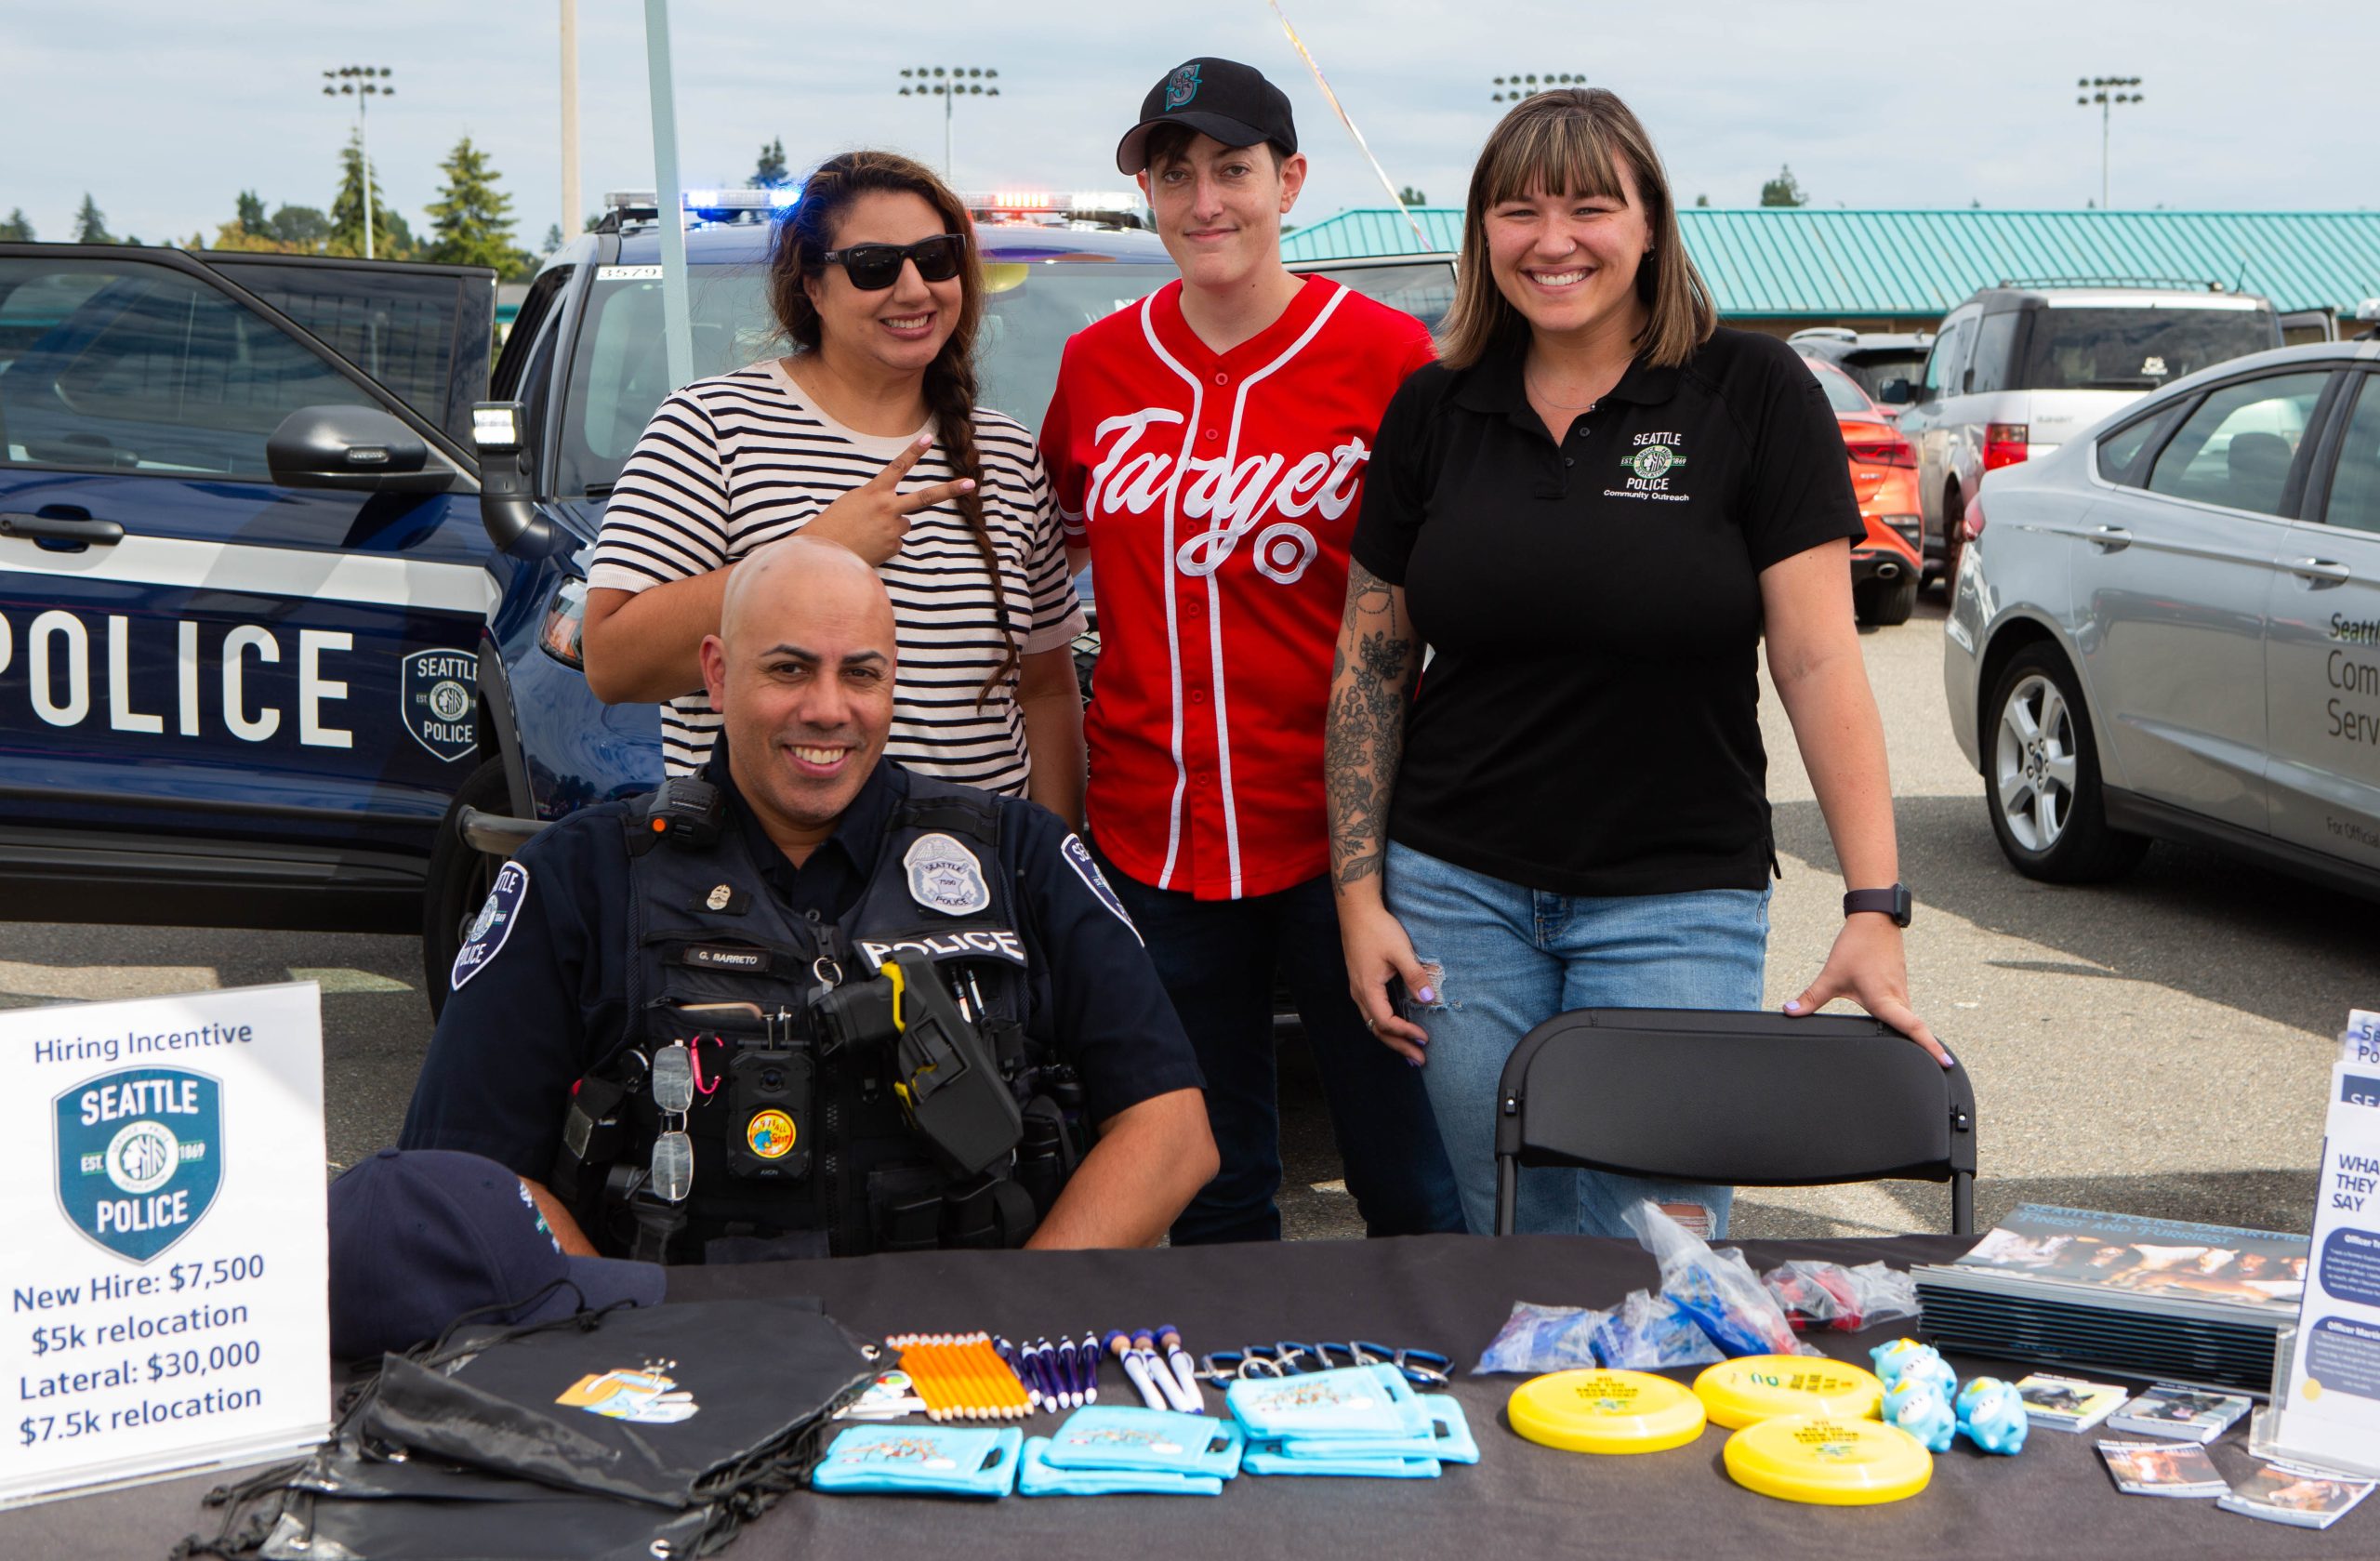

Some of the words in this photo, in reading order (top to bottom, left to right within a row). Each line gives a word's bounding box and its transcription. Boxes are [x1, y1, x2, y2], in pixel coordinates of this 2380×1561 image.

[600, 269, 663, 278] 3579
[1633, 432, 1682, 446] SEATTLE
[1086, 407, 1371, 576] Target
[1603, 489, 1649, 500] Community
[1651, 492, 1690, 501] Outreach
[1626, 478, 1670, 491] POLICE
[423, 721, 473, 743] POLICE
[925, 862, 963, 872] SEATTLE
[935, 895, 969, 906] POLICE
[698, 951, 709, 960] G.
[712, 952, 758, 965] BARRETO
[34, 1038, 119, 1063] Hiring
[127, 1023, 253, 1054] Incentive
[81, 1079, 199, 1126] SEATTLE
[81, 1155, 104, 1172] EST.
[179, 1143, 205, 1160] 1869
[2339, 1153, 2380, 1176] WHA
[2335, 1173, 2377, 1195] THEY
[97, 1189, 189, 1234] POLICE
[2332, 1193, 2365, 1212] SAY
[2017, 1211, 2086, 1228] FINEST
[2090, 1221, 2132, 1233] AND
[2137, 1225, 2233, 1245] FURRIEST
[2190, 1223, 2311, 1243] DEPARTMEN
[13, 1287, 80, 1313] New
[90, 1274, 161, 1303] Hire:
[169, 1254, 264, 1293] $7,500
[32, 1325, 87, 1357] $5k
[97, 1304, 248, 1344] relocation
[20, 1360, 139, 1401] Lateral:
[147, 1341, 261, 1382] $30,000
[20, 1409, 102, 1449] $7.5k
[112, 1388, 262, 1431] relocation
